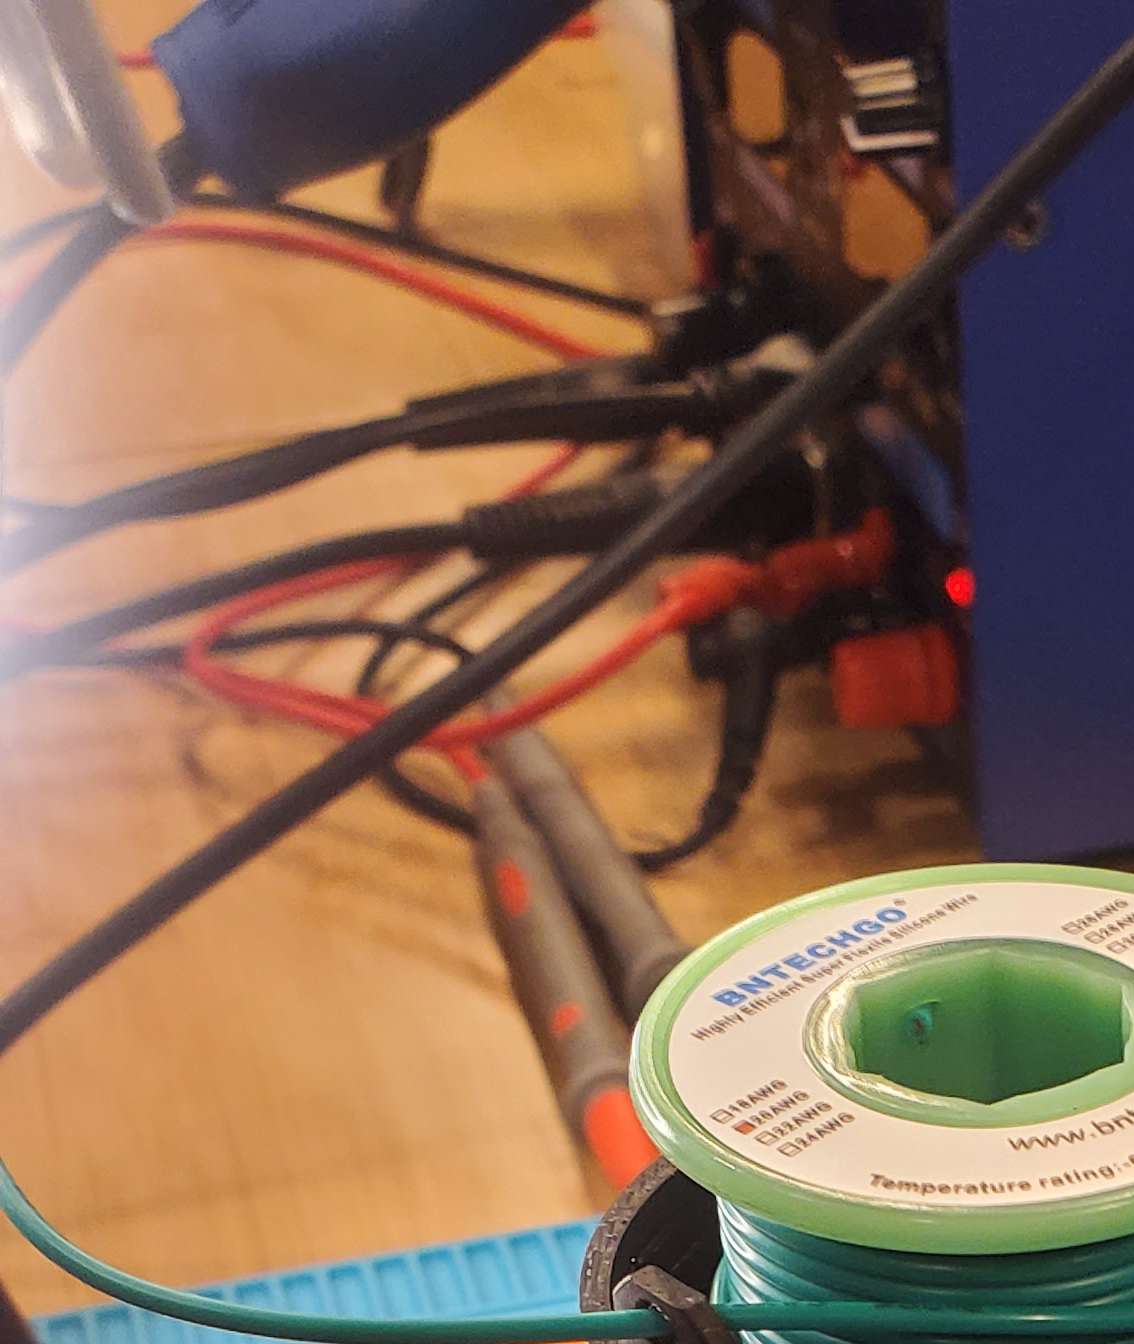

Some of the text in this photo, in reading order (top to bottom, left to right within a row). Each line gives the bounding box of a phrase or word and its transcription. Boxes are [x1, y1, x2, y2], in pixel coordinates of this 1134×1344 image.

[690, 1011, 745, 1041] Highly
[740, 981, 804, 1017] Efficient
[800, 959, 845, 986] Super
[890, 911, 947, 940] Silicone
[944, 893, 978, 914] Wire
[870, 1173, 1032, 1197] Temperature
